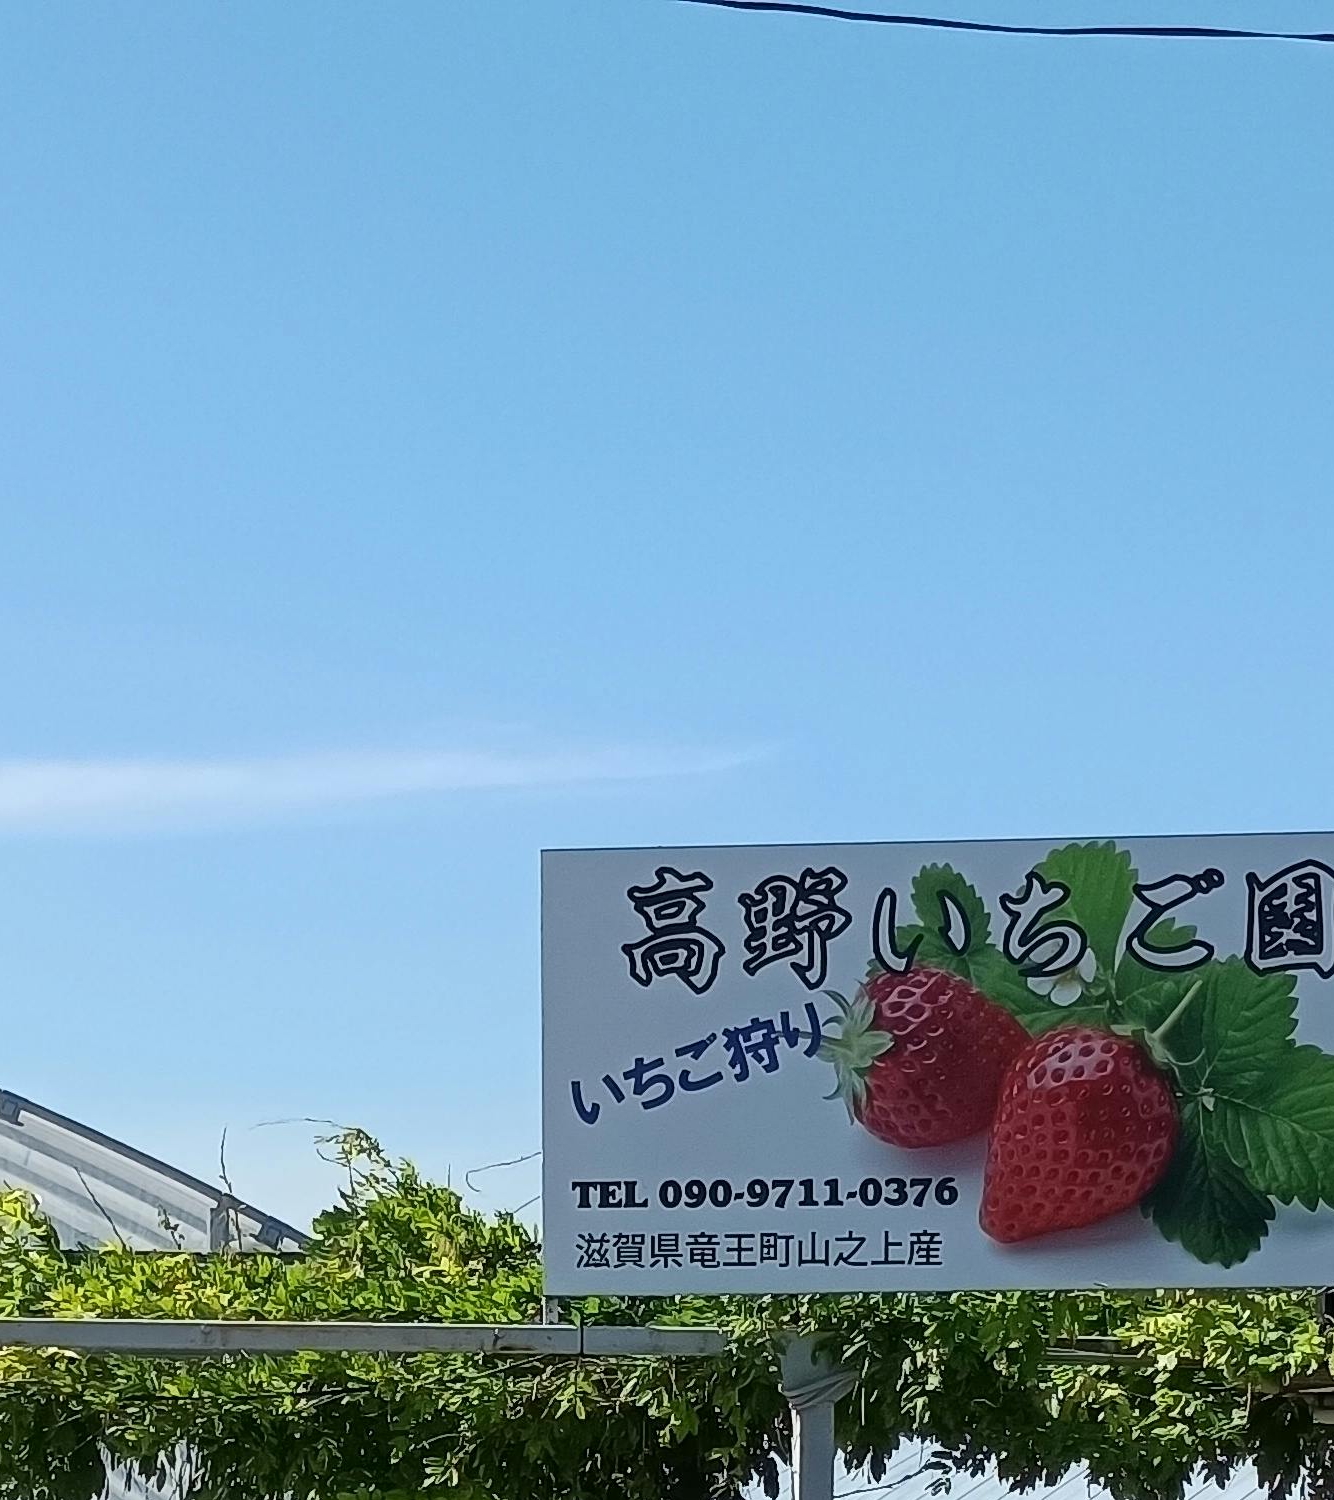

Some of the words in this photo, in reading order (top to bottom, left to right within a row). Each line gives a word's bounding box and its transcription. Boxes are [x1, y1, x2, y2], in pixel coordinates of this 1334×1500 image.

[571, 1002, 821, 1125] いちご狩り
[571, 1180, 649, 1208] TEL
[658, 1177, 958, 1207] 090-9711-0376
[575, 1229, 943, 1268] 滋賀県竜王町山之上産
